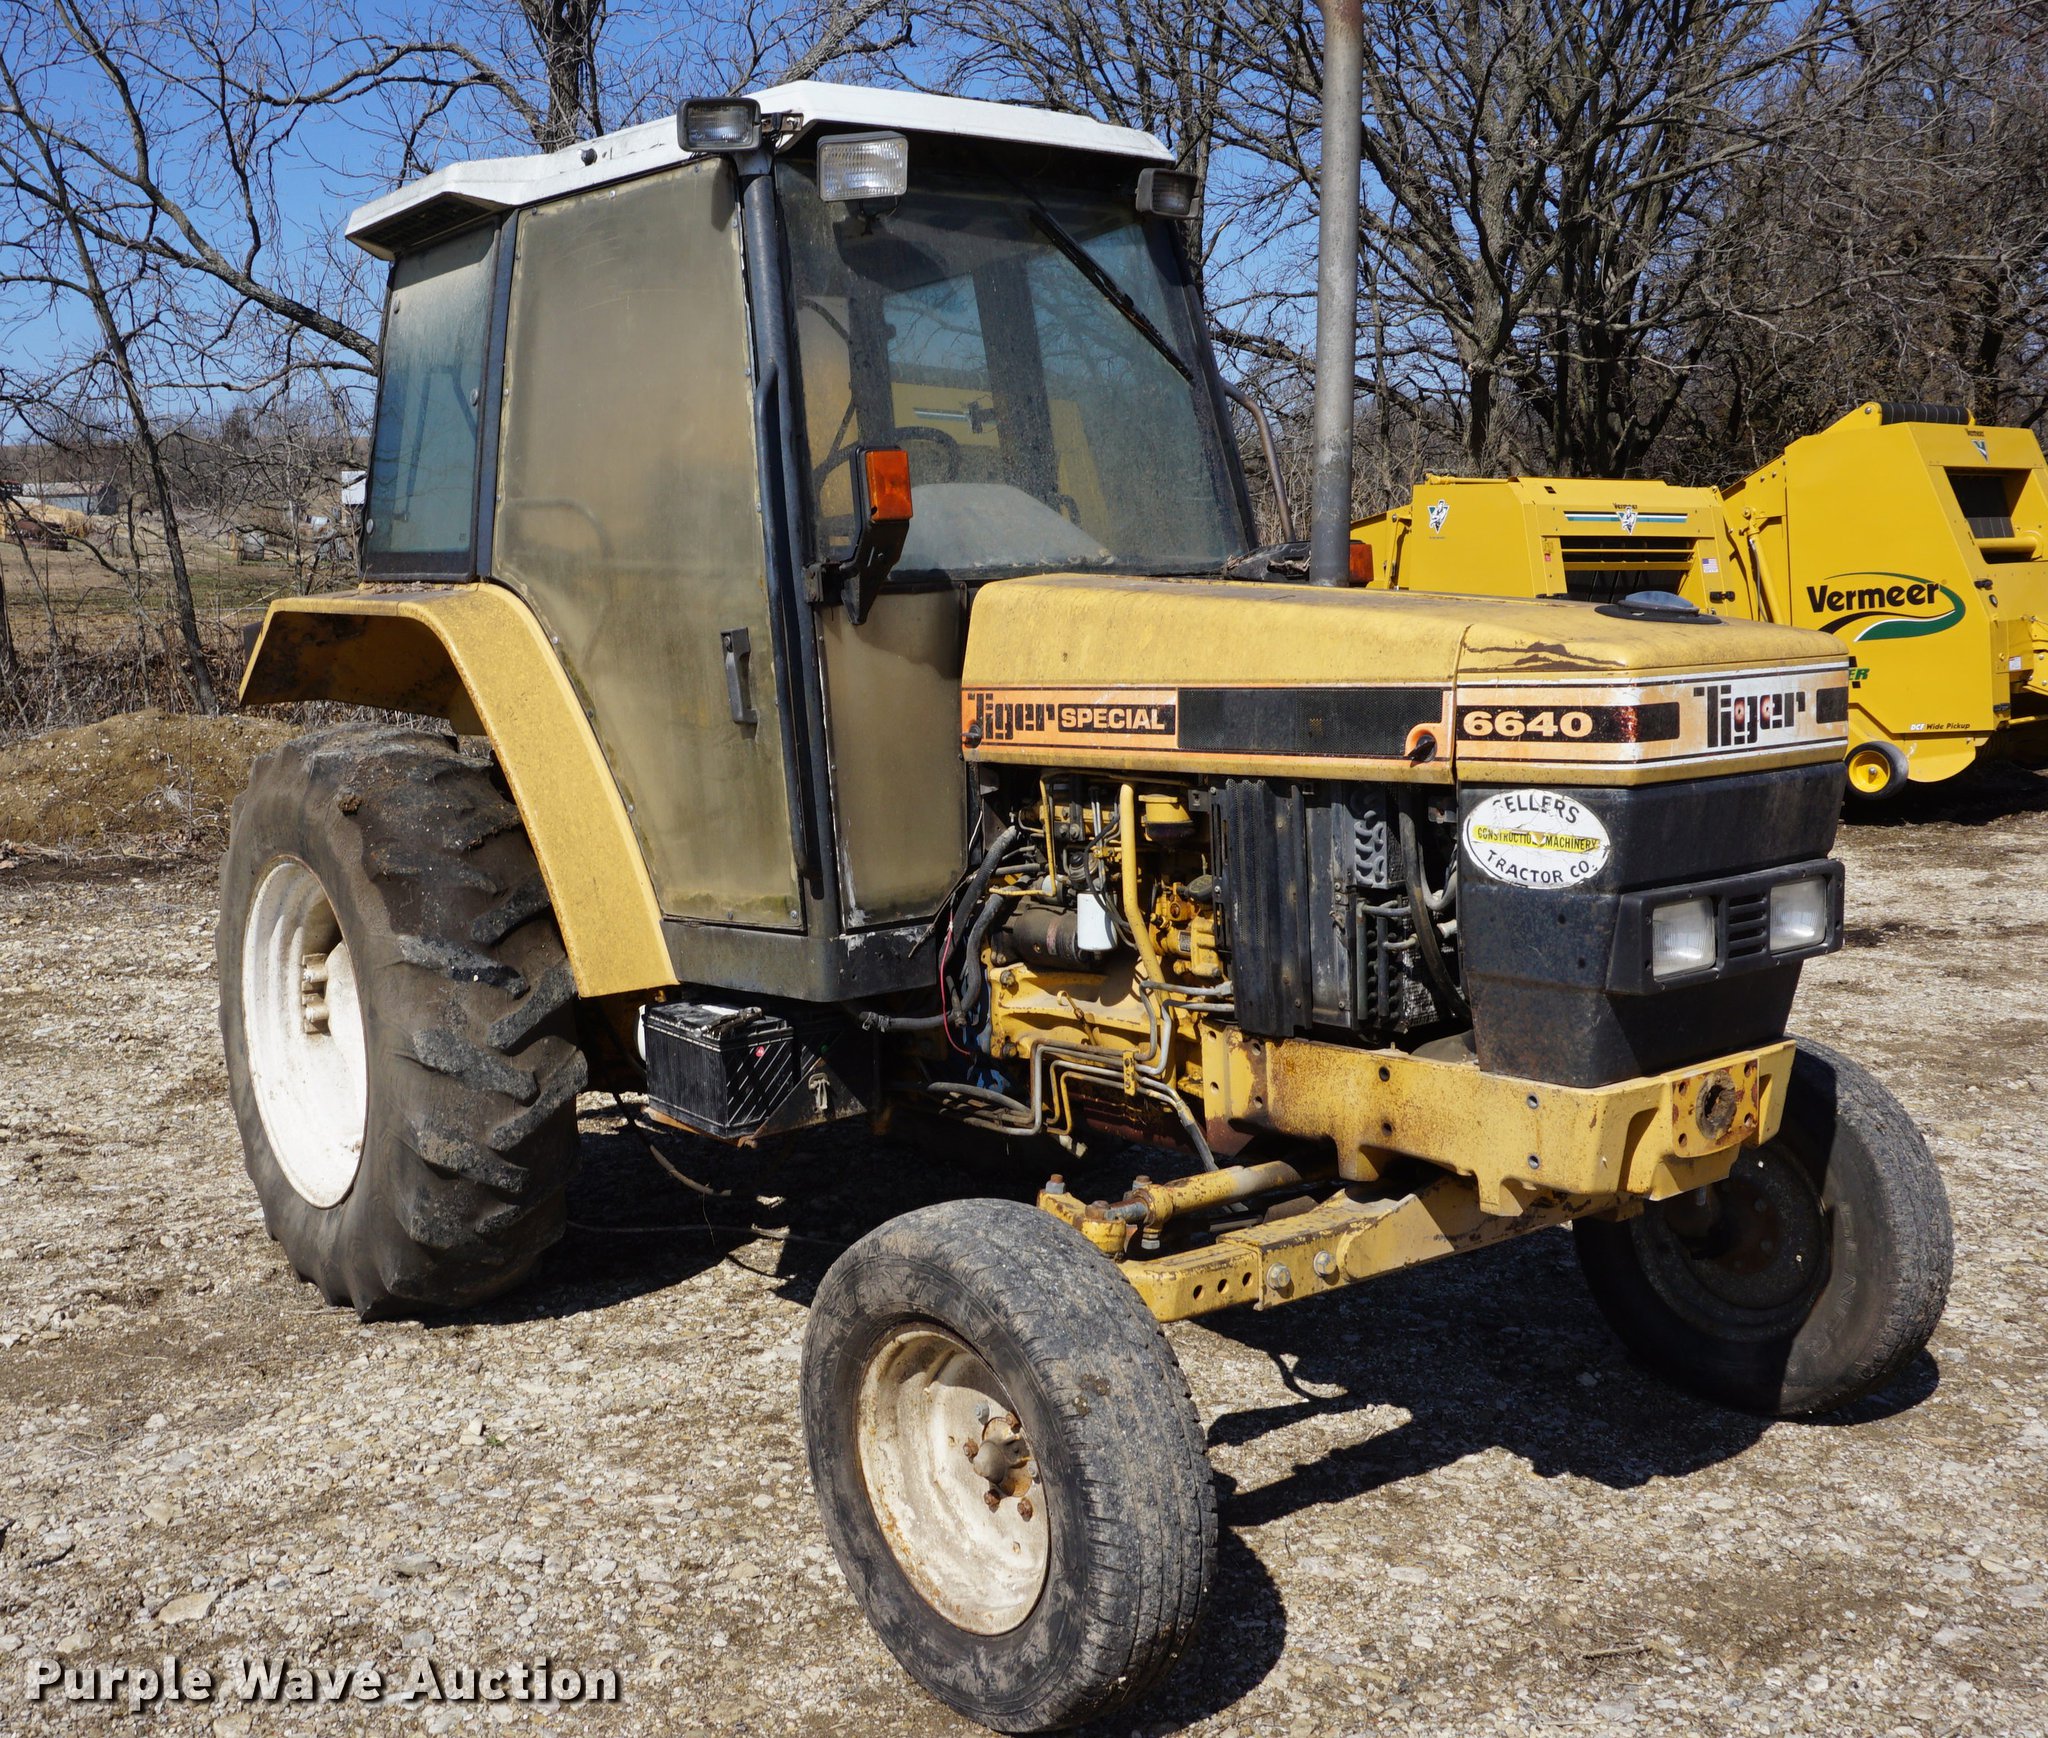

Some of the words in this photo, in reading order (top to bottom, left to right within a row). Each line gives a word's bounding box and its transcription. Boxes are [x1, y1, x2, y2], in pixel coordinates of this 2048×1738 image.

[1806, 583, 1940, 613] Vermeer
[967, 693, 1055, 741] Tiger
[1060, 706, 1166, 731] SPECIAL
[1462, 710, 1594, 738] 6640
[1693, 684, 1806, 748] Tiger
[1477, 826, 1539, 846] CONSTRUCTIO
[1545, 834, 1598, 851] MACHINERY
[1486, 849, 1564, 884] TRACTOR
